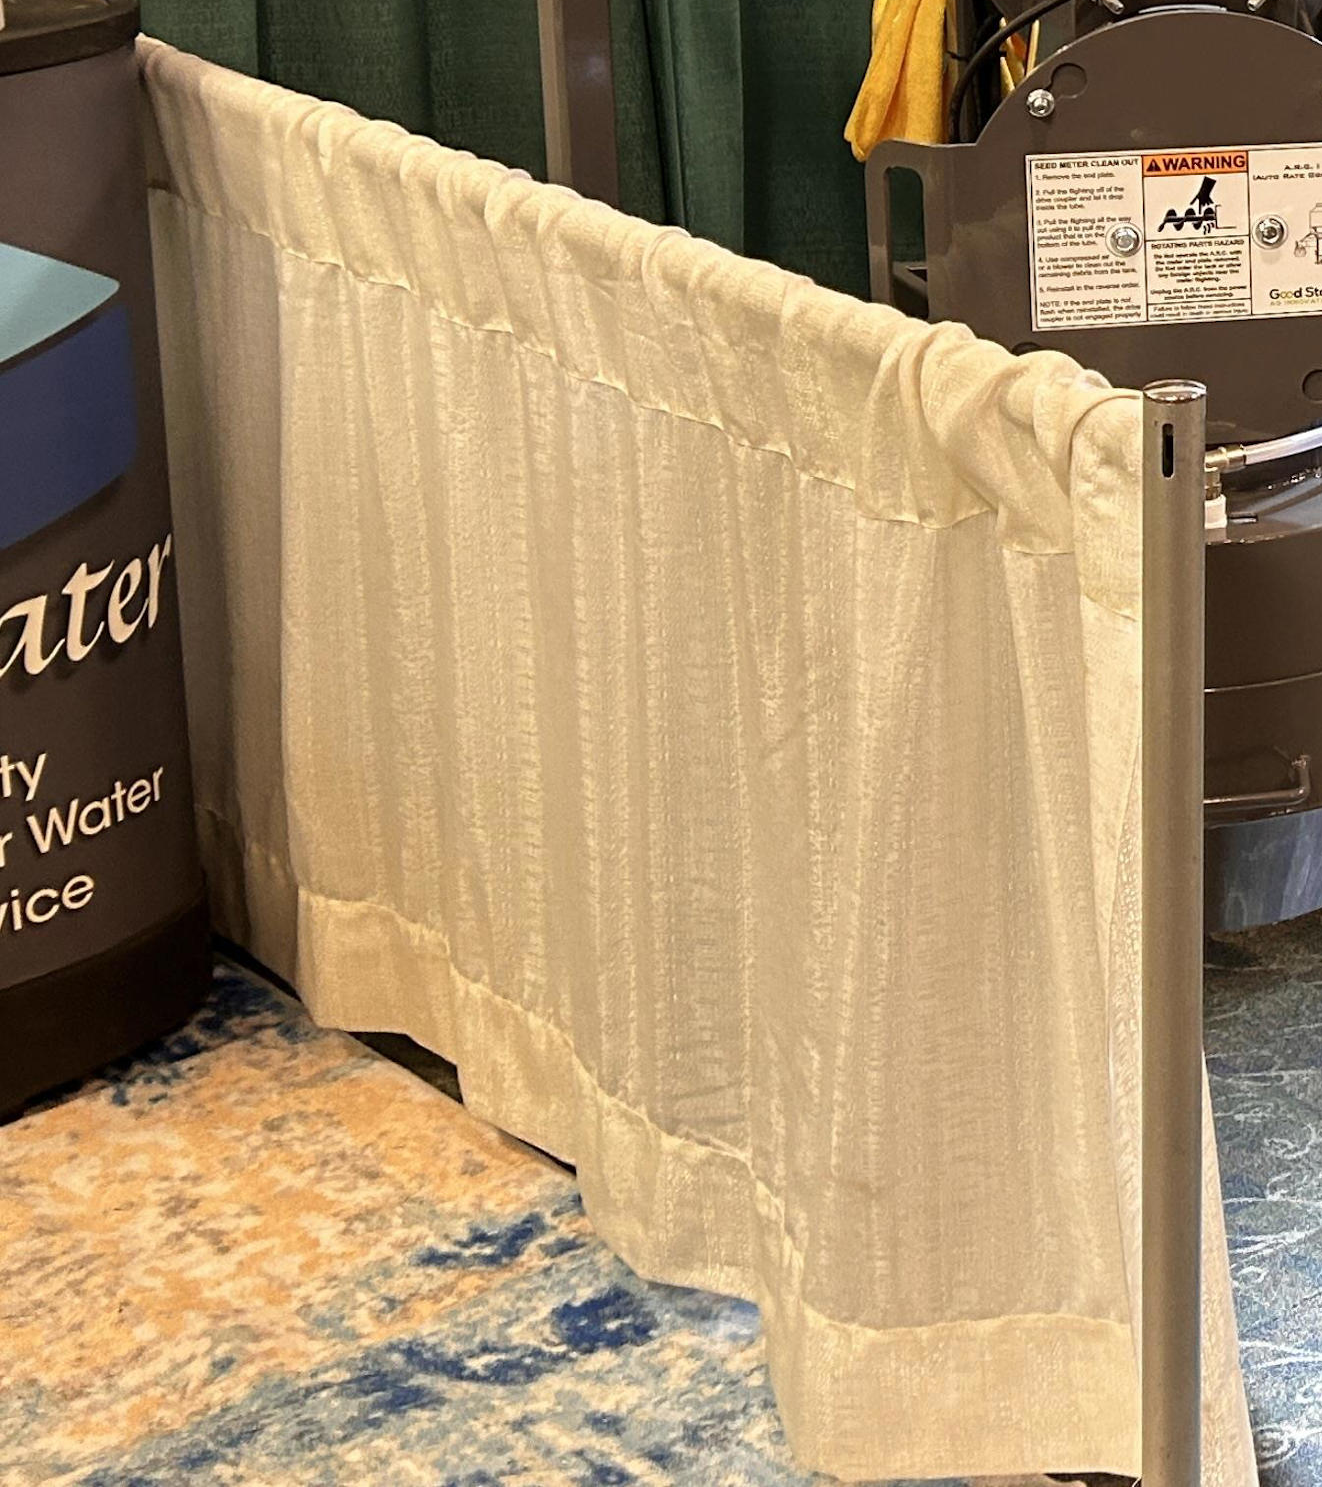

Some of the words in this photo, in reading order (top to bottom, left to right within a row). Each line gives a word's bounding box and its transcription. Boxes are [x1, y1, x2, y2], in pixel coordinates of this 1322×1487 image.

[1091, 159, 1119, 167] CLEAN
[1121, 158, 1139, 166] OUT
[1163, 155, 1245, 171] WARNING
[1269, 288, 1302, 299] Good
[0, 533, 172, 677] ater
[26, 766, 164, 855] Water
